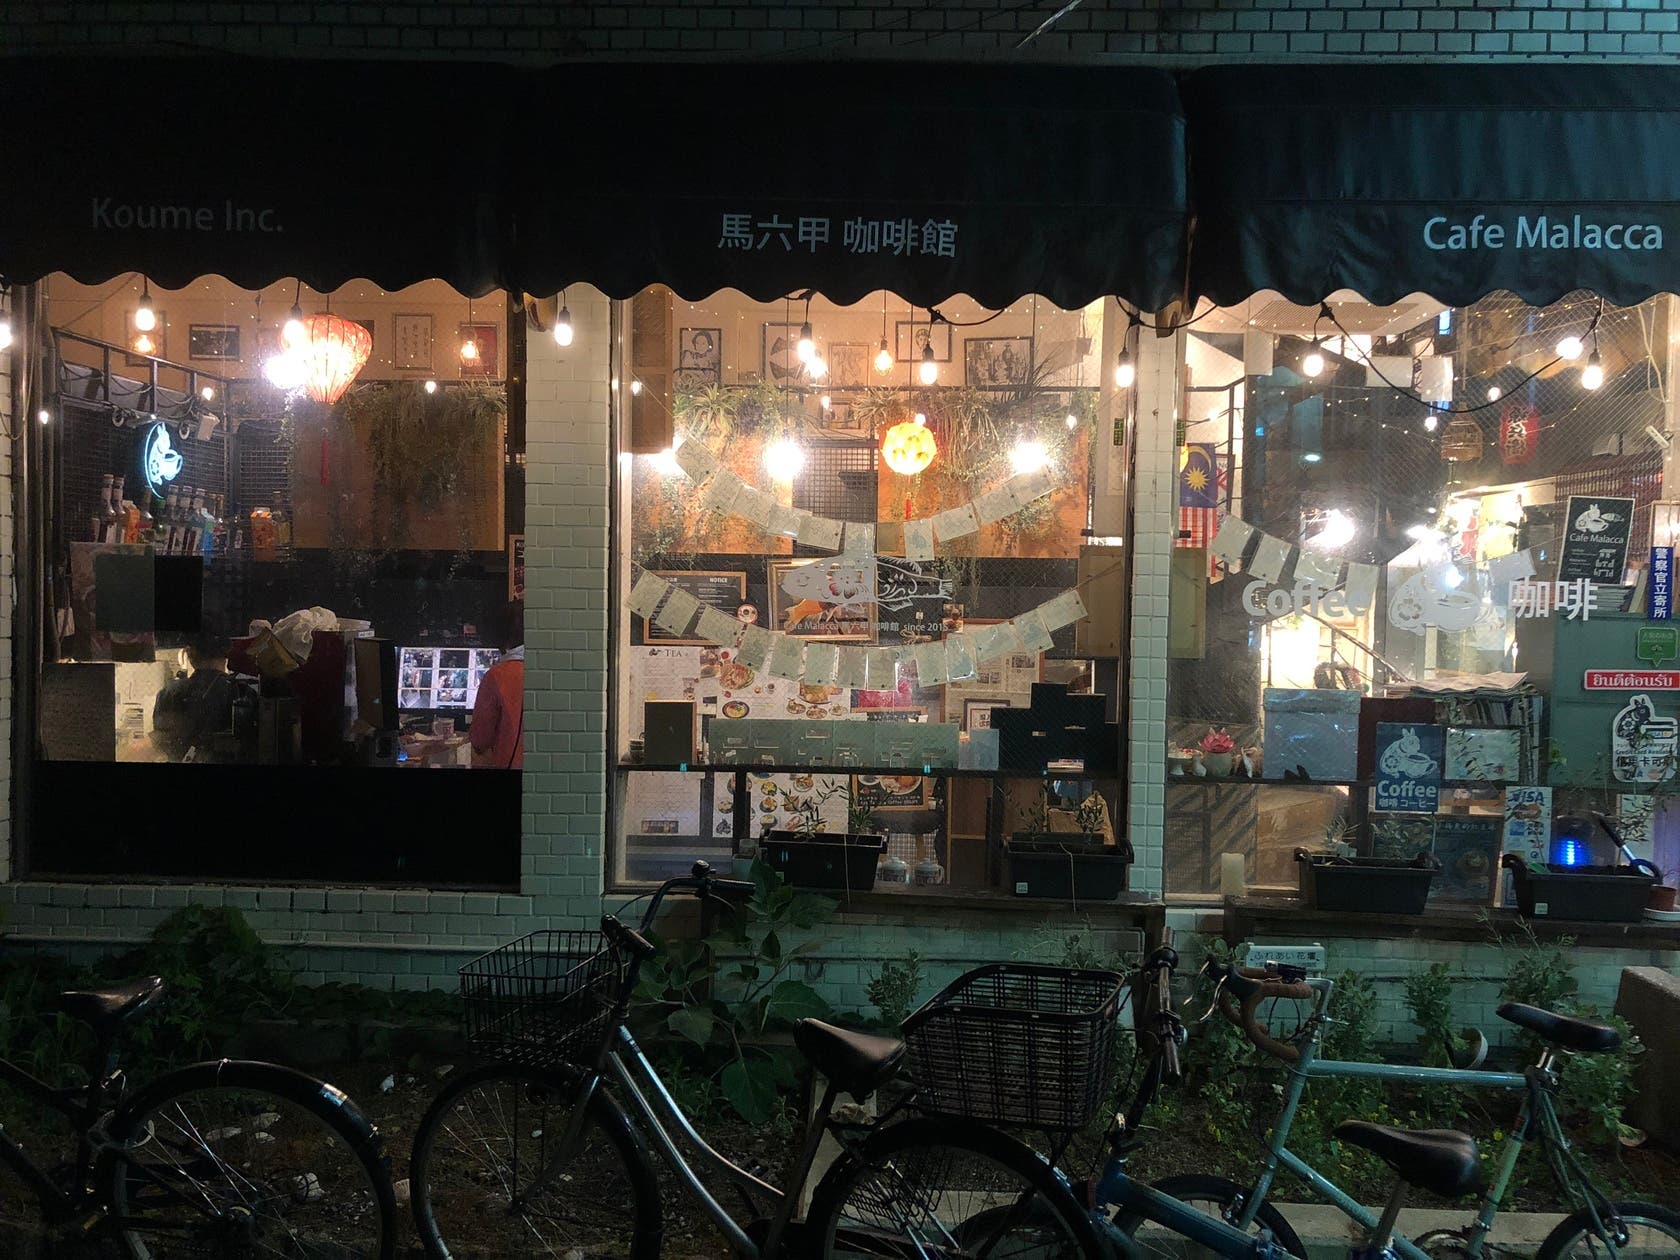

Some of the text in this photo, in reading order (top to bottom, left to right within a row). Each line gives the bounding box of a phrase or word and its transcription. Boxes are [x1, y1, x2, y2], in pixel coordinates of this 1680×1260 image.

[92, 198, 284, 232] Koume Inc.
[718, 213, 958, 257] 馬六甲 咖啡館
[1423, 214, 1663, 250] Cafe Malacca
[1569, 532, 1625, 545] Cafe Malacca
[1654, 547, 1668, 619] 警察官立寄所
[1242, 579, 1373, 617] Coffee
[1509, 576, 1599, 621] 咖啡
[804, 621, 839, 631] Malacca
[903, 622, 926, 632] since
[664, 648, 682, 658] TEA
[1593, 673, 1673, 687] ยินดีต้อนรับ
[1377, 780, 1437, 798] Coffee
[1401, 799, 1435, 808] コーヒー
